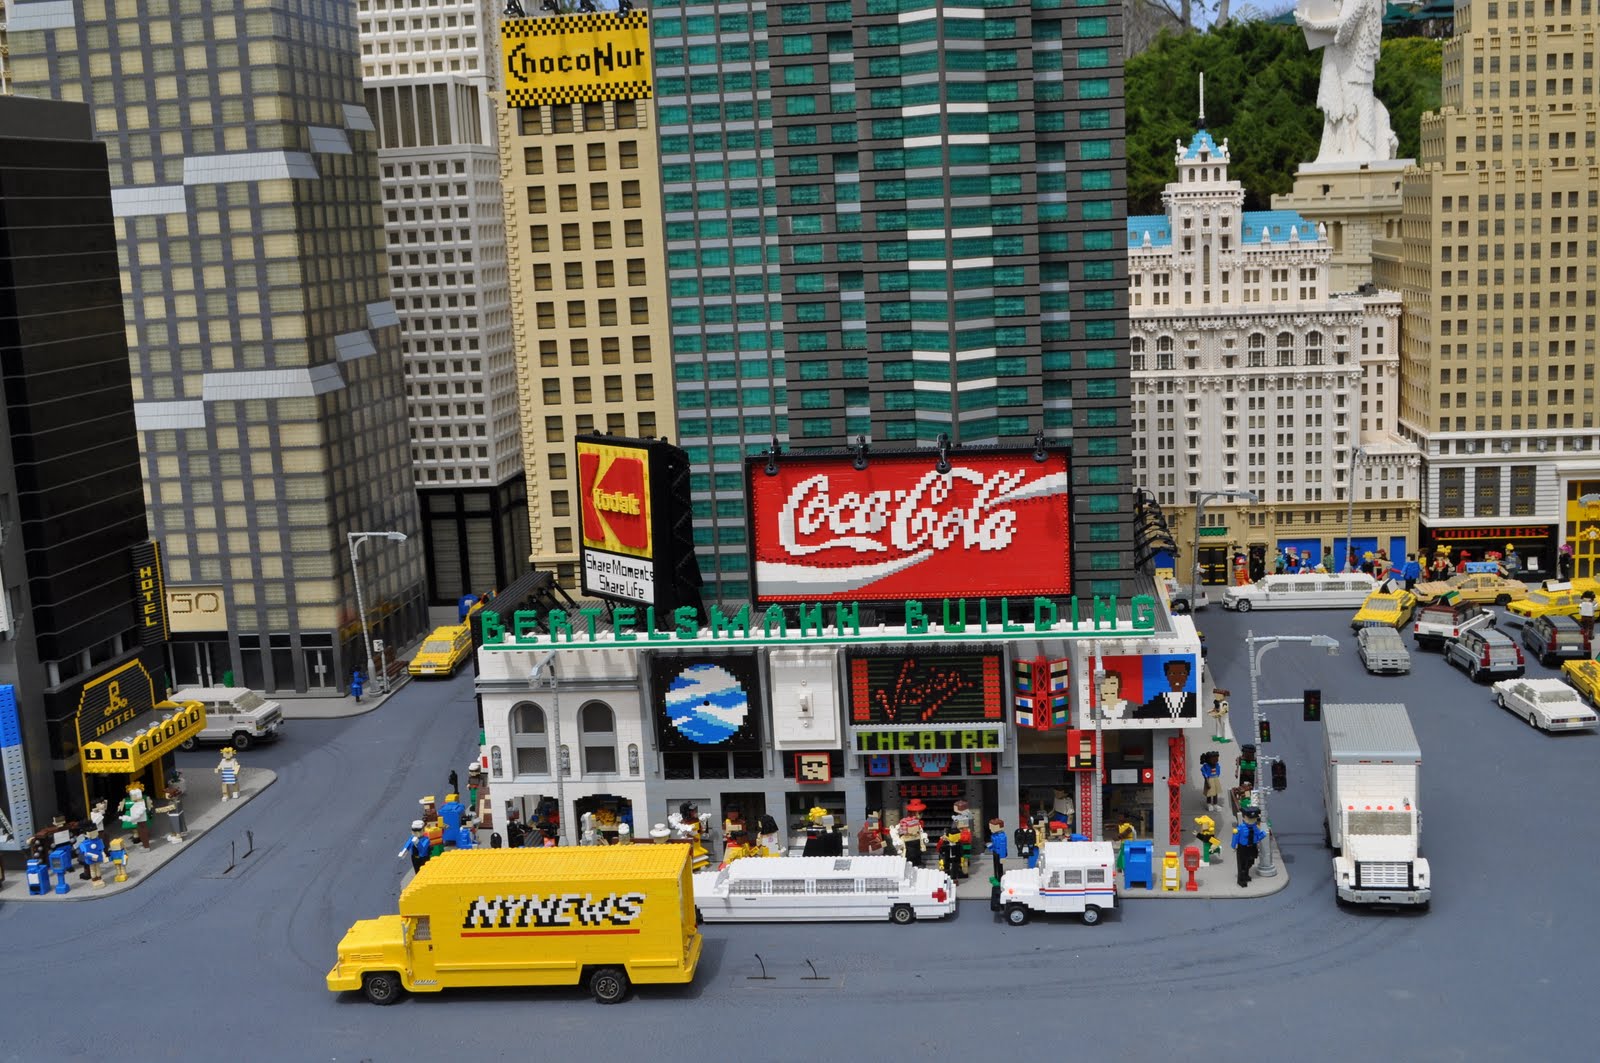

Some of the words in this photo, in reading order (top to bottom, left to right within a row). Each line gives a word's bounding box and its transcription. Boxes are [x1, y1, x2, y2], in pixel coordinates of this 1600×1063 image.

[508, 42, 645, 83] ChocoNut
[593, 488, 641, 515] Kodak
[1431, 528, 1549, 540] COMPUTERS
[585, 553, 612, 574] Share
[612, 559, 654, 582] Moments
[140, 566, 158, 627] HOTEL
[599, 574, 625, 595] Share
[626, 581, 645, 599] Life
[481, 602, 860, 644] BERTELSMANN
[904, 594, 1155, 634] BUILDING
[96, 708, 137, 737] HOTEL
[856, 730, 999, 751] THEATRE
[462, 892, 647, 929] NYNEWS
